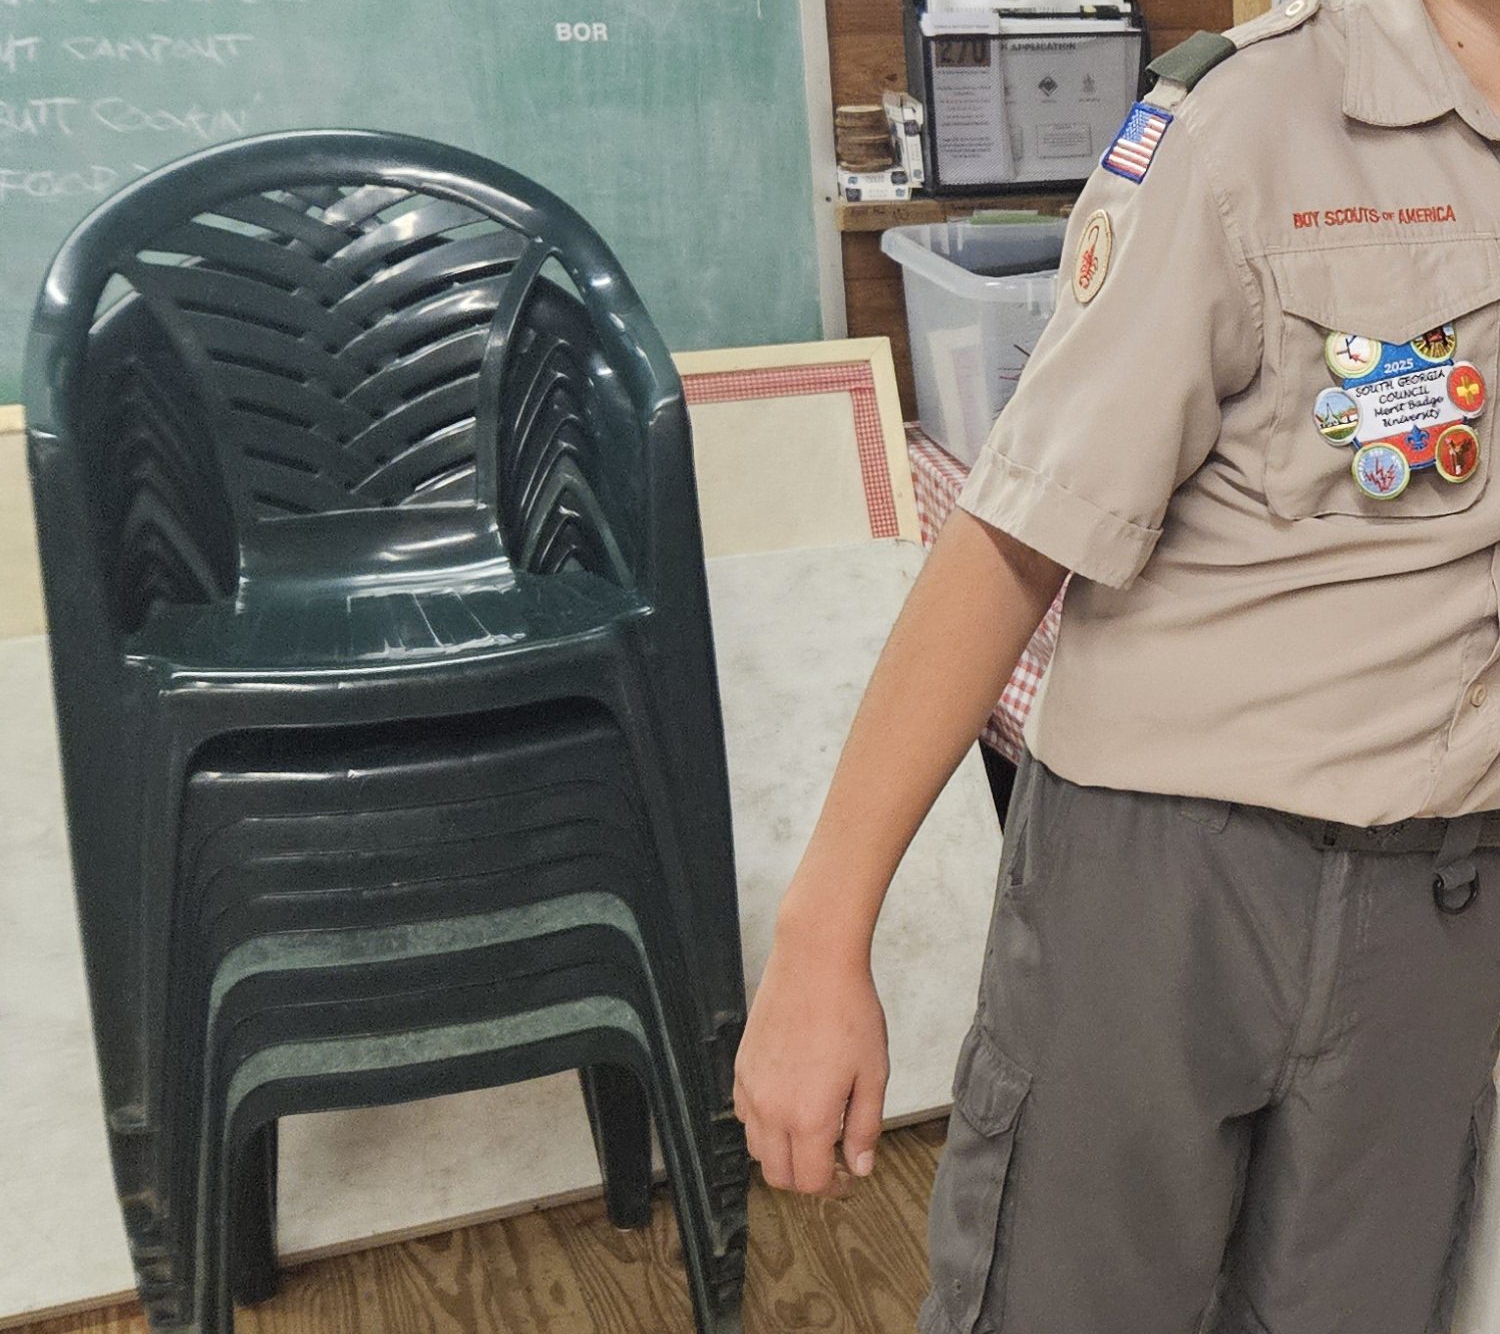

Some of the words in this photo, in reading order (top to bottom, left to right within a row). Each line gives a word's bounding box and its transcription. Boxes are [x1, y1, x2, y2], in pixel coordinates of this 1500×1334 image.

[555, 21, 609, 42] BOR
[1010, 42, 1076, 52] APPLICATION
[1293, 210, 1320, 229] BOY
[1324, 207, 1380, 226] SCOUTS
[1398, 204, 1457, 225] AMERICA
[1384, 358, 1414, 374] 2025
[1355, 380, 1394, 398] SOUTH
[1397, 369, 1445, 388] GEORGIA
[1379, 386, 1430, 404] COUNCIL
[1374, 403, 1403, 417] Merit
[1408, 395, 1444, 408] Badge
[1382, 408, 1440, 427] University
